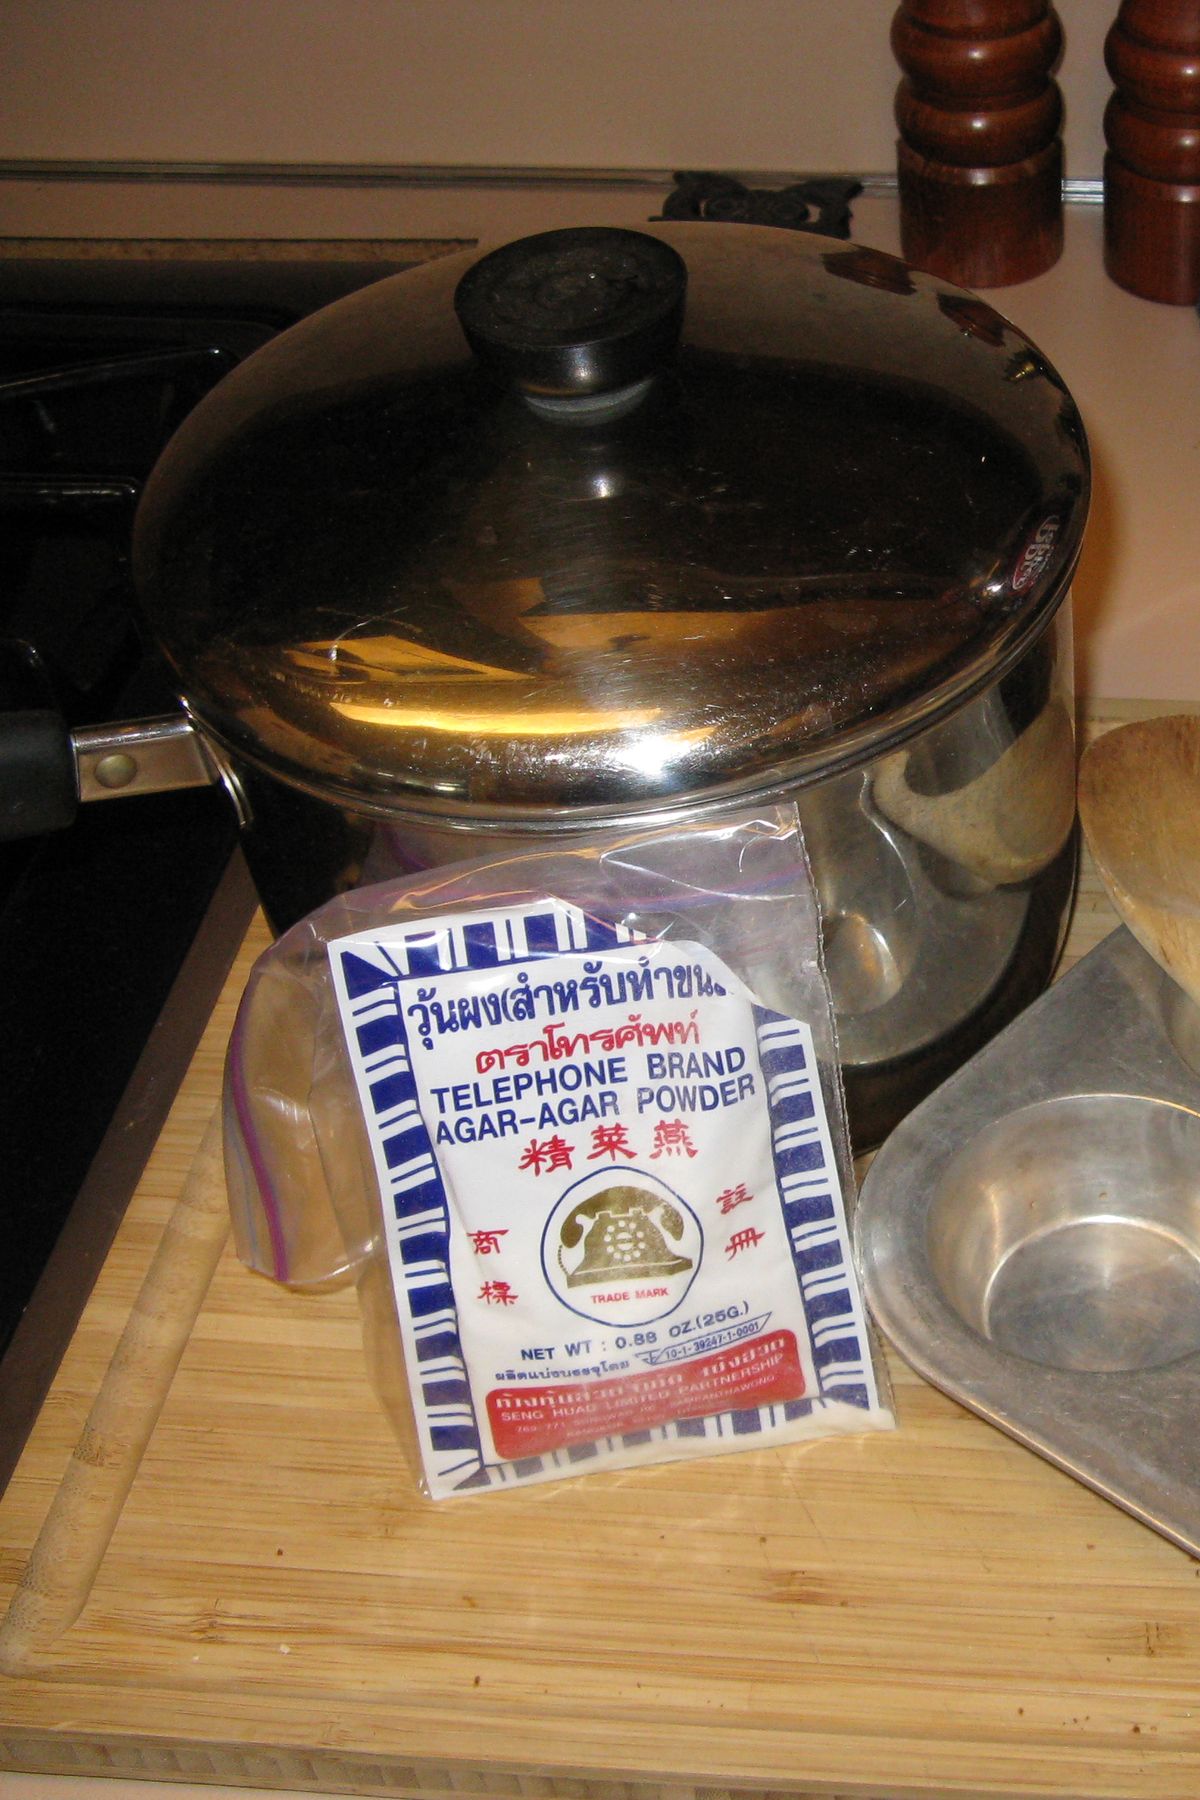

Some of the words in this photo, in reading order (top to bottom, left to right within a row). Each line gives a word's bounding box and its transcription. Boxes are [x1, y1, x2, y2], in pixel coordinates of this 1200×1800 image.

[474, 1009, 702, 1075] ตราโทรศัพท์
[430, 1056, 629, 1115] TELEPHONE
[646, 1046, 747, 1081] BRAND
[435, 1090, 621, 1147] AGAR-AGAR
[637, 1072, 756, 1115] POWDER
[591, 1291, 630, 1304] TRADE
[635, 1287, 670, 1299] MARK
[520, 1347, 556, 1361] NET
[565, 1339, 592, 1358] WT
[614, 1331, 658, 1350] 0.88
[501, 1410, 544, 1422] SENG
[678, 1353, 784, 1395] PARTNERSHIP
